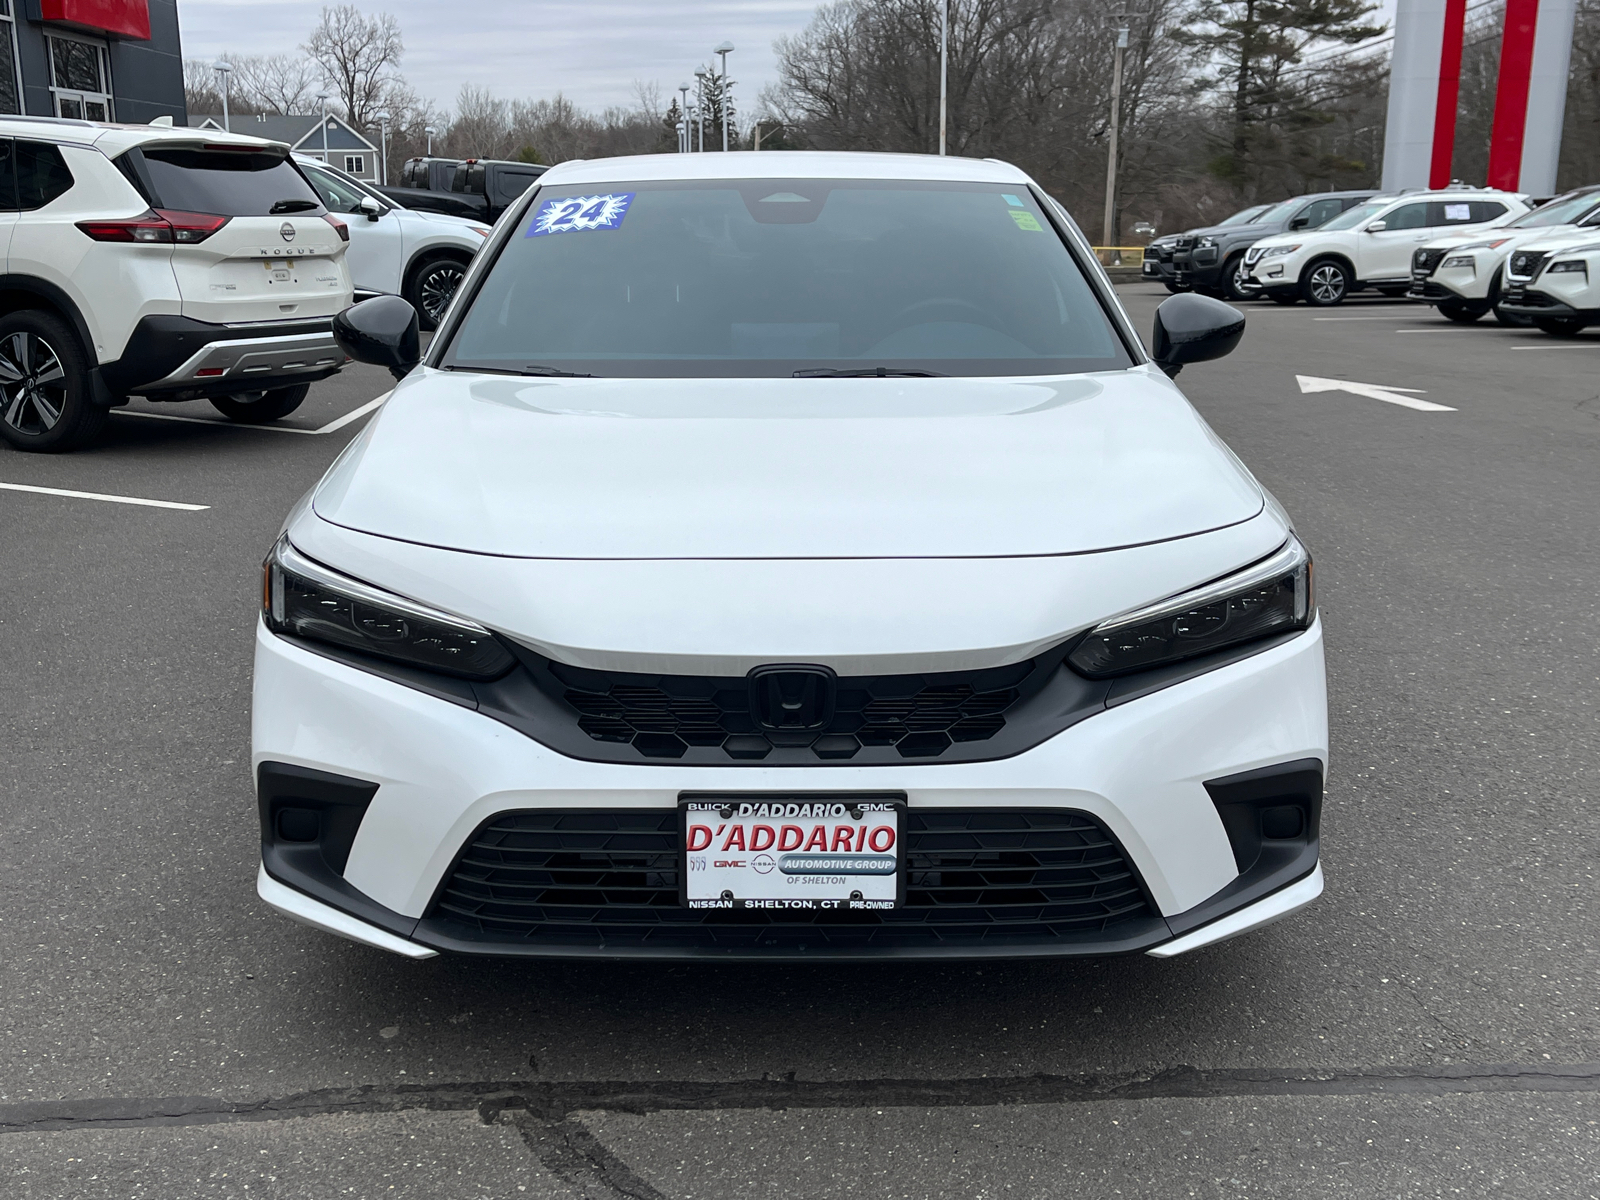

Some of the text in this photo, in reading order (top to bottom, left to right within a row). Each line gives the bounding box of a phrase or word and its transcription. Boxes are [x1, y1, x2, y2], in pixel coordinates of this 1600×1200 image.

[551, 199, 609, 226] 24
[687, 803, 731, 811] BUICK
[738, 803, 846, 818] D'ADDARIO
[857, 803, 895, 811] GMC
[686, 824, 896, 852] D'ADDARIO
[713, 860, 747, 868] GMC
[784, 859, 892, 869] AUTOMOTIVE GROUP
[786, 876, 846, 885] OF SHELTON
[688, 900, 733, 909] NISSAN
[744, 900, 840, 910] SHELTON, CT
[849, 901, 894, 909] PRE-OWNED
